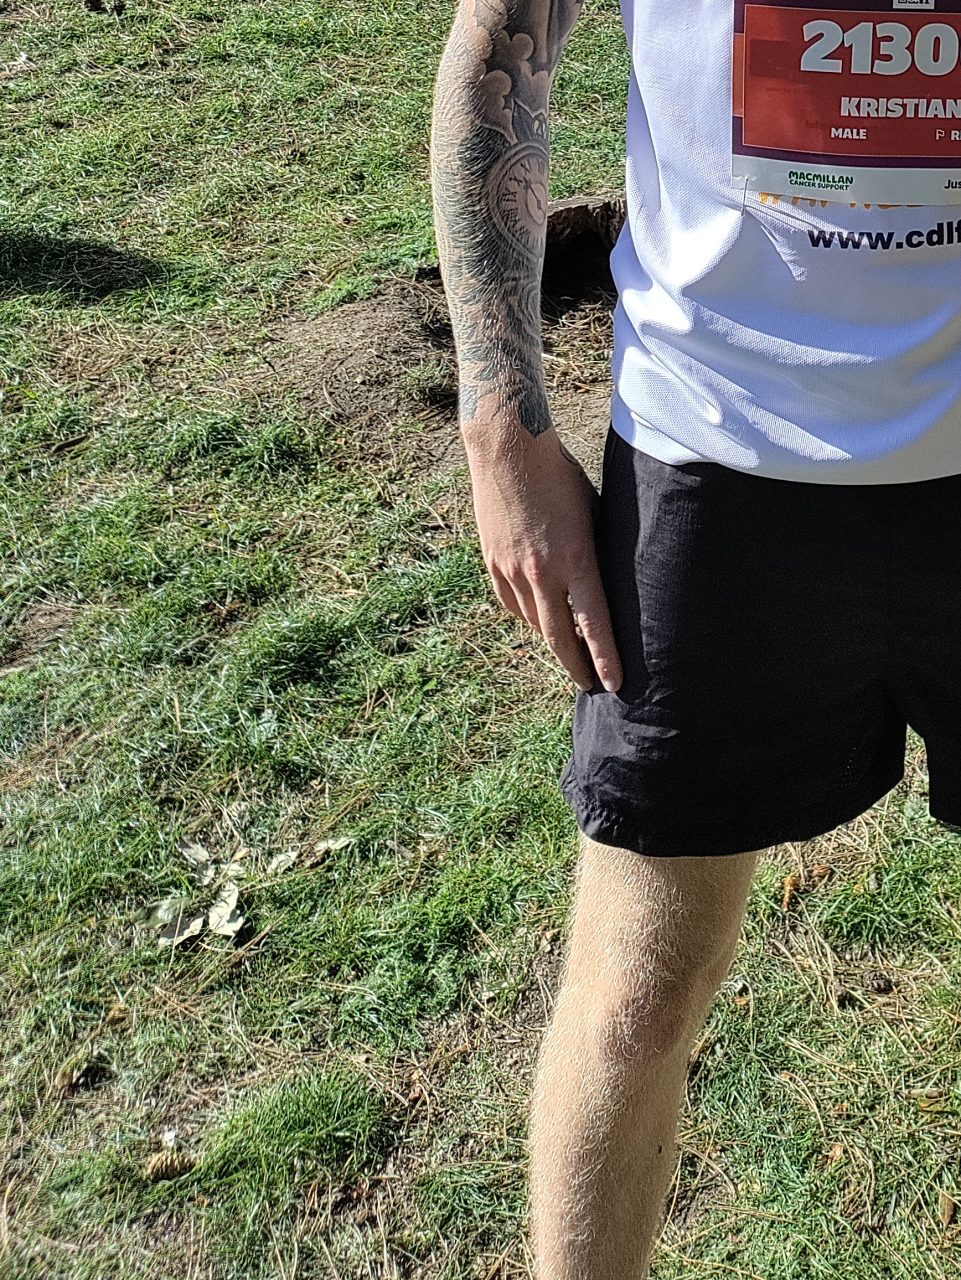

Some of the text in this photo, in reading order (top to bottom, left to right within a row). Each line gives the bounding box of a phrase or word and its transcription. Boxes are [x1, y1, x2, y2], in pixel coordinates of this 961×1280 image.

[830, 127, 867, 140] MALE
[789, 170, 854, 184] MACMILLAN
[790, 179, 849, 191] CANCER SUPPORT
